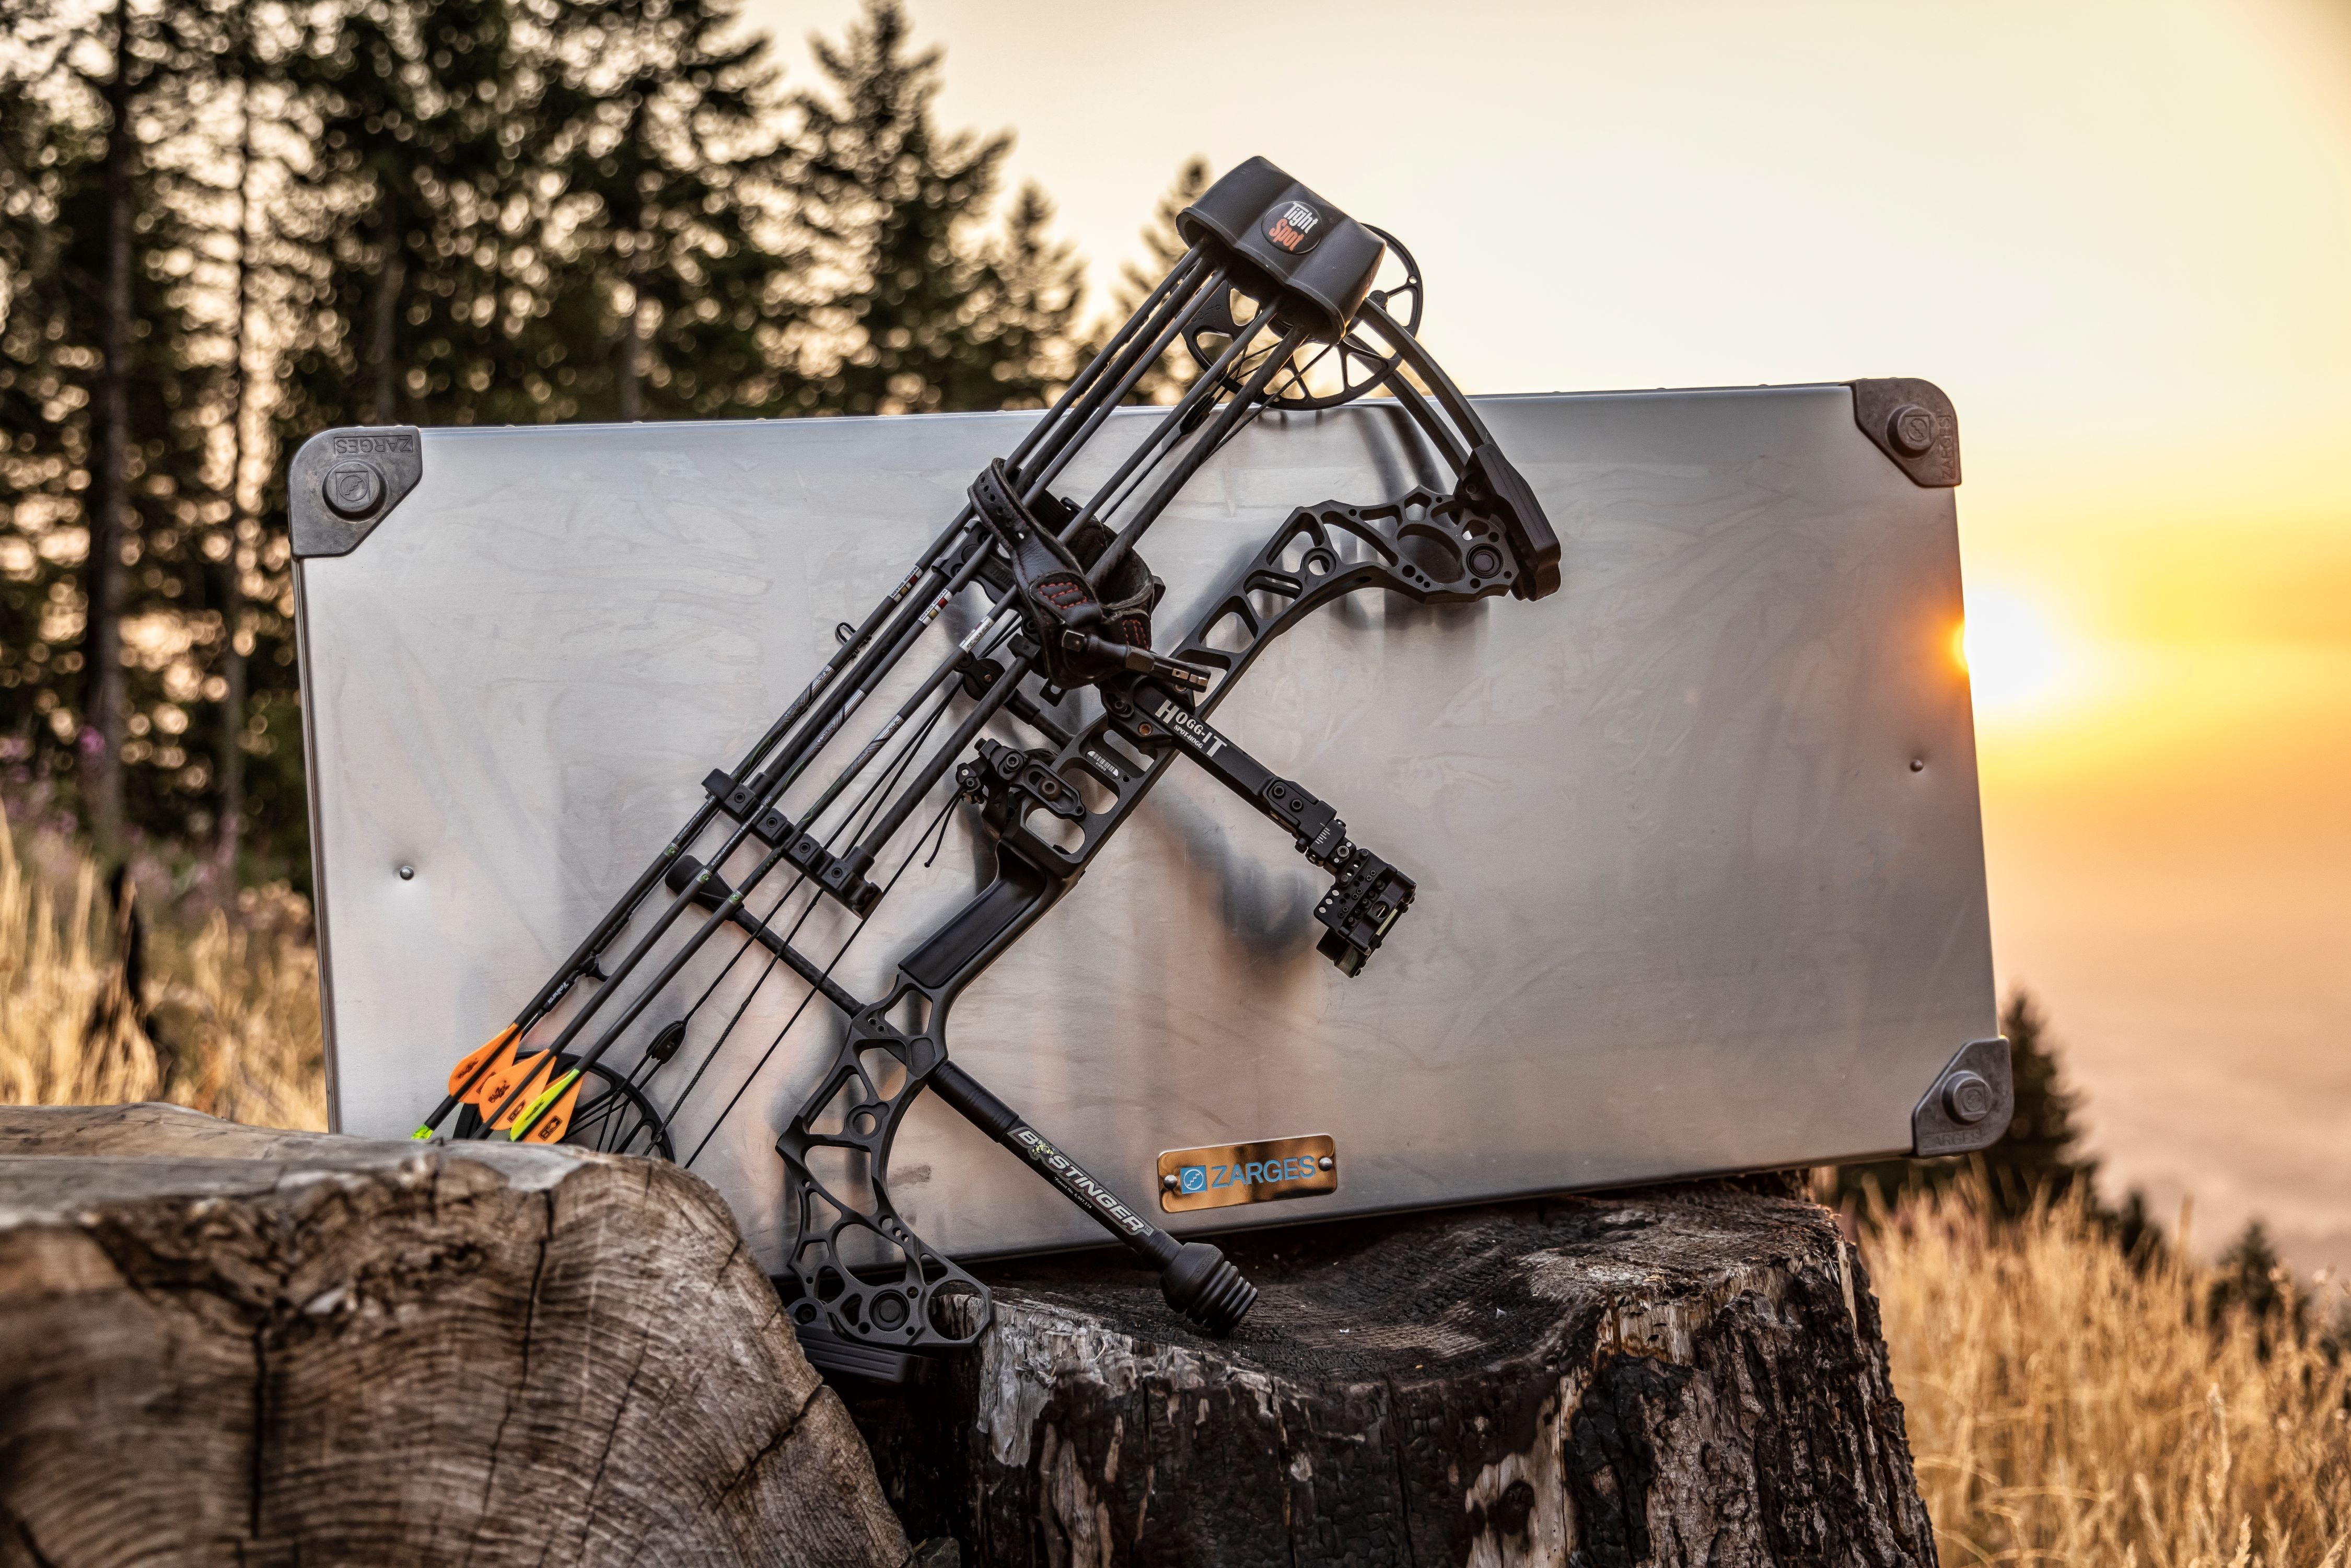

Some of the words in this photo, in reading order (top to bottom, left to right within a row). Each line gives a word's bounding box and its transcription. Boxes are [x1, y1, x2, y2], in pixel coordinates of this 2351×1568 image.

[1283, 202, 1318, 234] Tight
[1268, 218, 1305, 251] Spot
[335, 436, 412, 454] ZARGES
[1939, 418, 1954, 480] ZARGES
[903, 565, 917, 582] MATCH
[890, 581, 904, 598] GRADE
[932, 588, 946, 605] MATCH
[919, 605, 933, 621] GRADE
[1155, 699, 1227, 758] HOGG-IT
[1173, 724, 1203, 749] SPOT-HOGG
[817, 733, 826, 744] USA
[1212, 1155, 1316, 1189] ZARGES
[1074, 1193, 1092, 1209] 6,997,174
